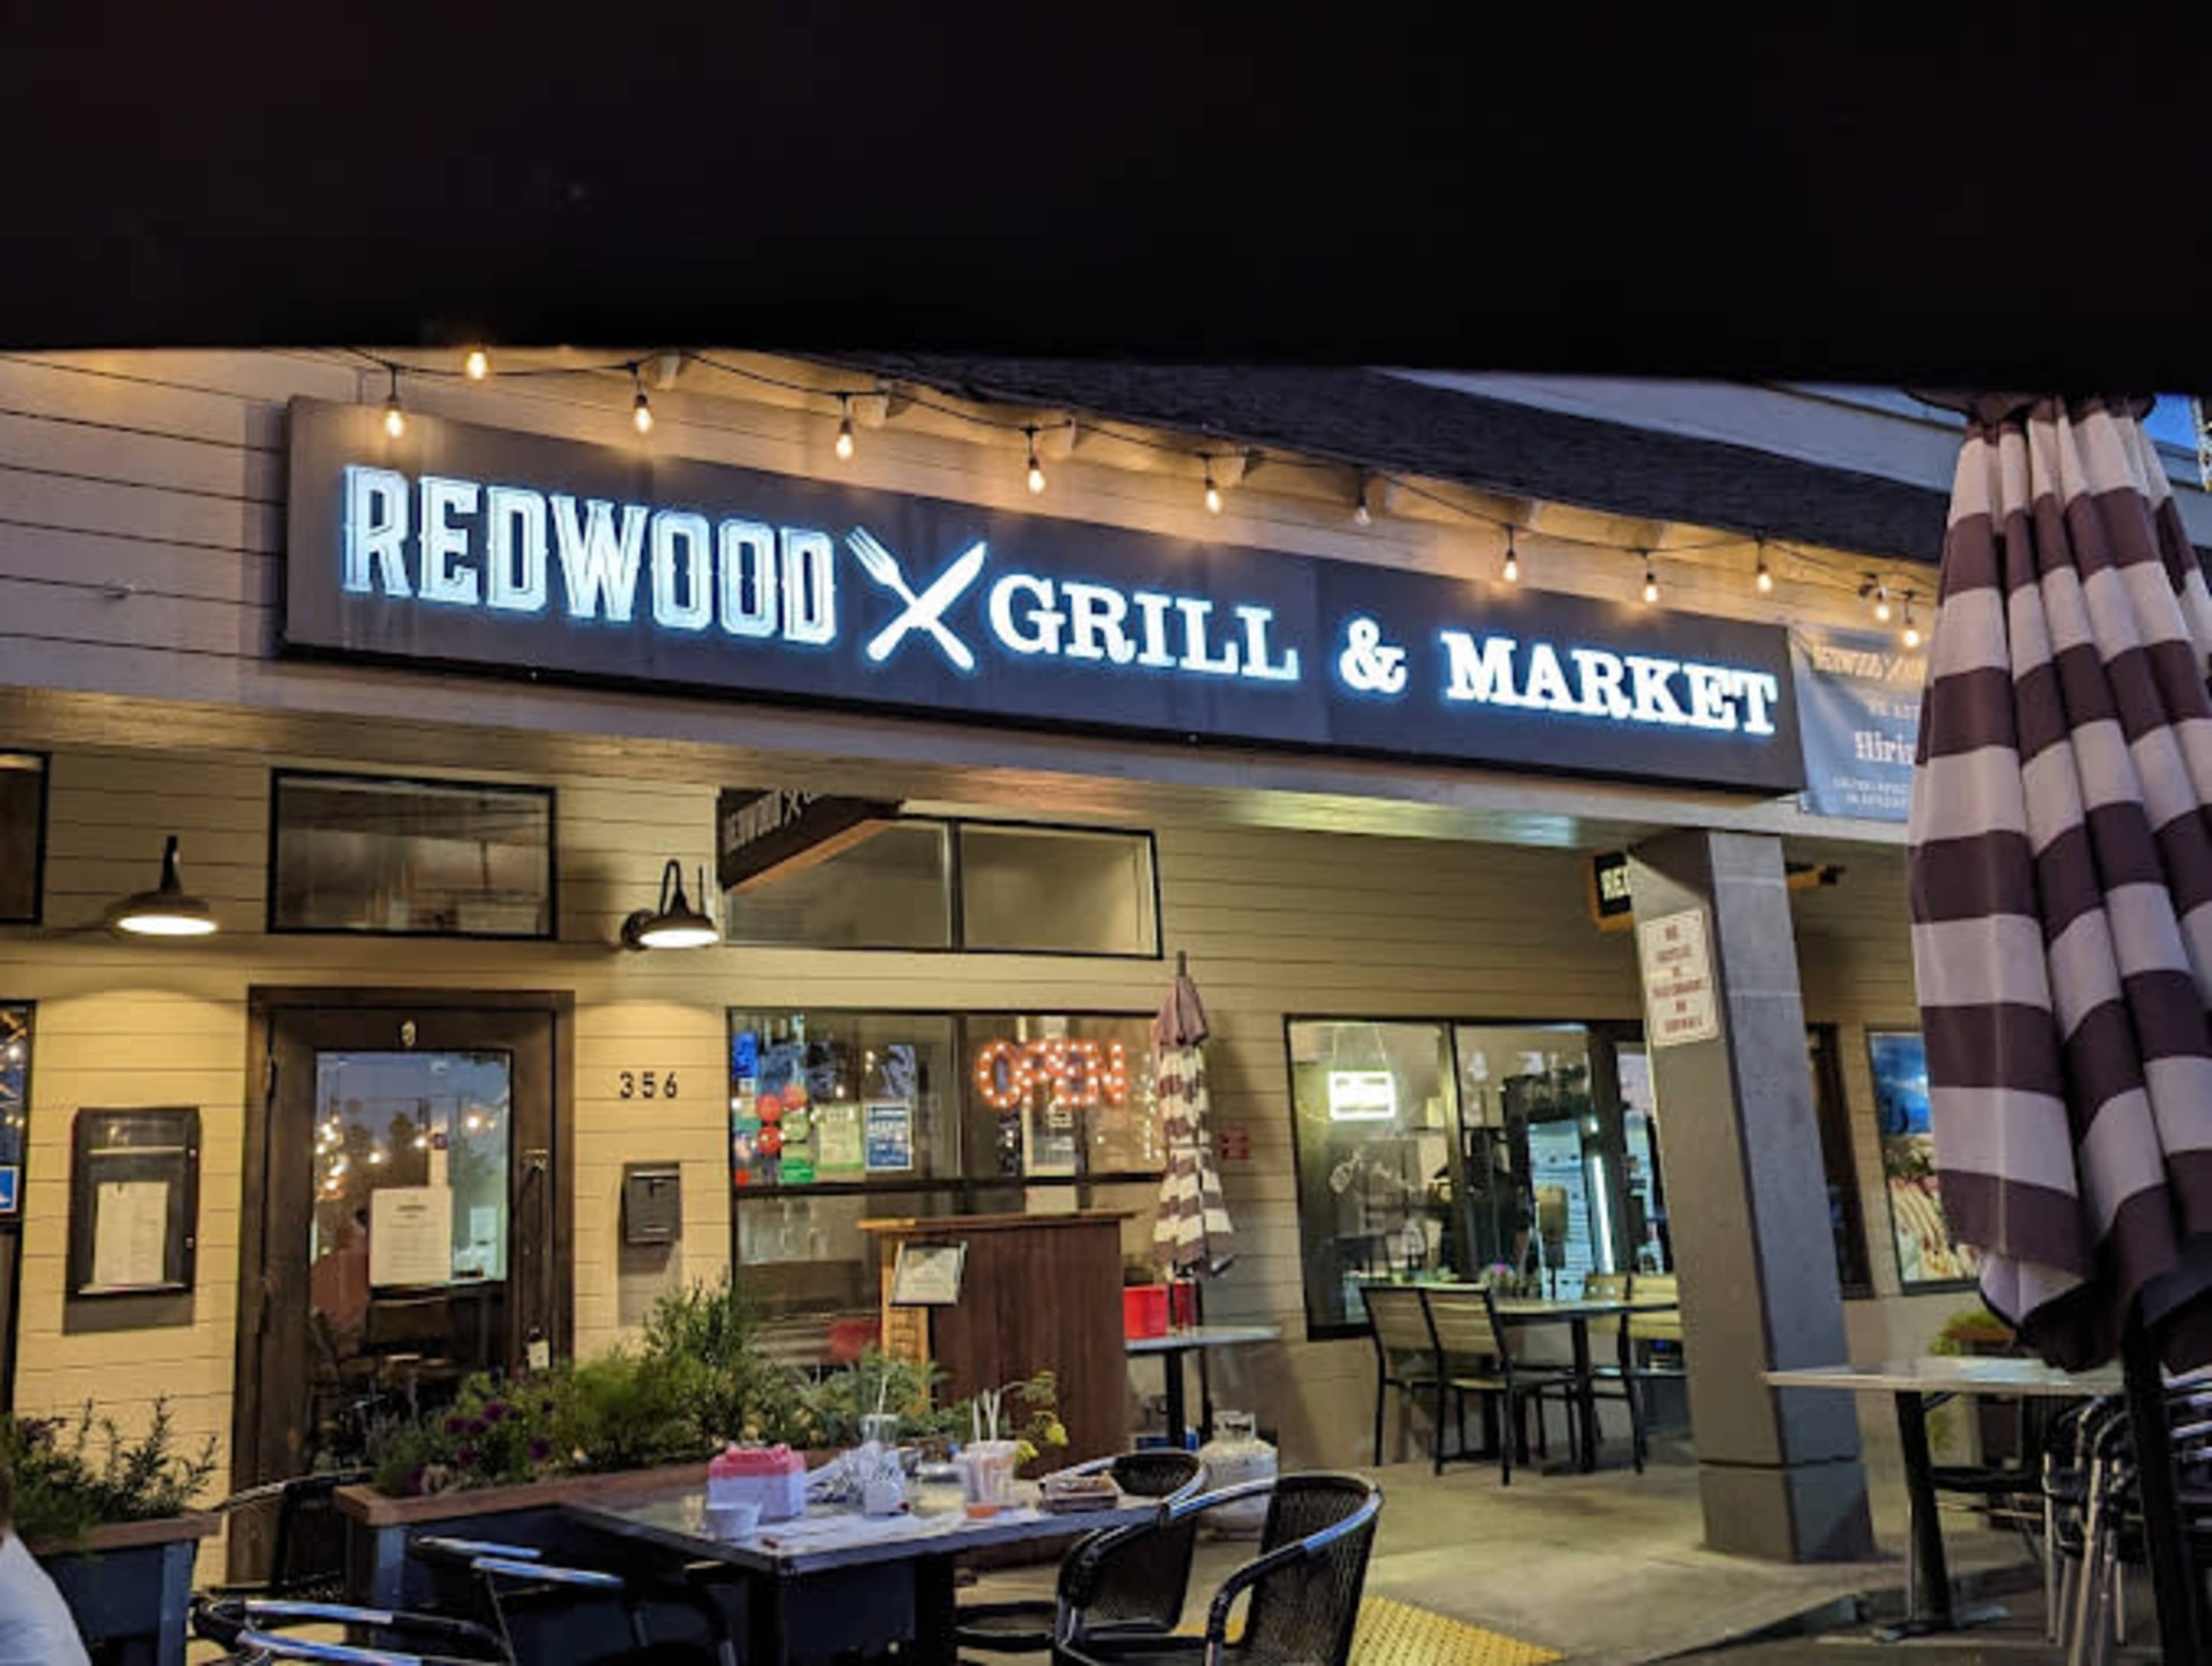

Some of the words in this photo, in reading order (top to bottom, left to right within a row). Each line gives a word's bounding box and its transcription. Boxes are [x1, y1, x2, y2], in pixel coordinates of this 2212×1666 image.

[343, 464, 838, 645] REDWOOD
[987, 572, 1300, 681] GRILL
[1338, 617, 1407, 693] &
[1439, 629, 1778, 735] MARKET
[619, 1071, 678, 1099] 356
[976, 1040, 1127, 1109] OPEN
